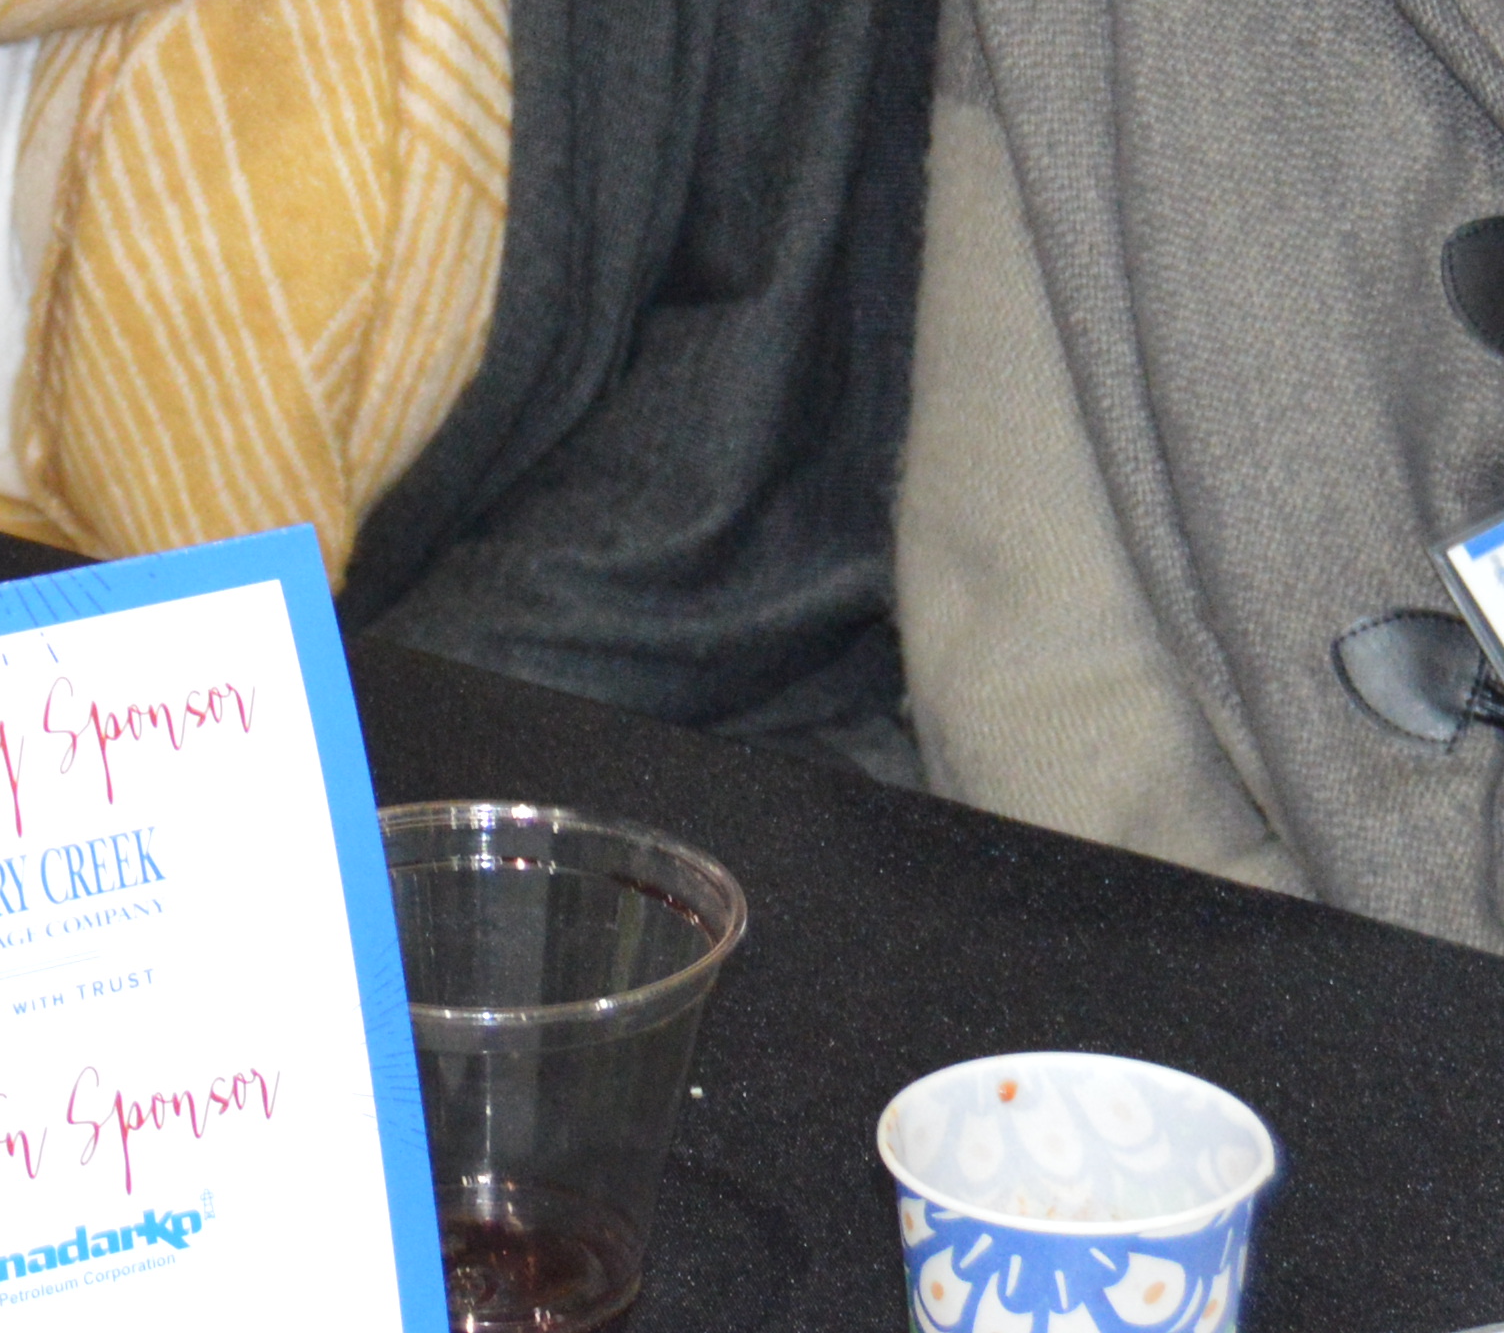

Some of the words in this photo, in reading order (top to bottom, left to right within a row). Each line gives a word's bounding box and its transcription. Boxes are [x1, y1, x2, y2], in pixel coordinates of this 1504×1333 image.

[43, 676, 255, 804] Sponsor
[40, 826, 167, 904] CREEK
[46, 897, 165, 939] COMPANY
[76, 968, 157, 1001] TRUST
[66, 1066, 280, 1195] Sponsor
[0, 1277, 79, 1307] Petroleum
[83, 1253, 177, 1285] Corporation
